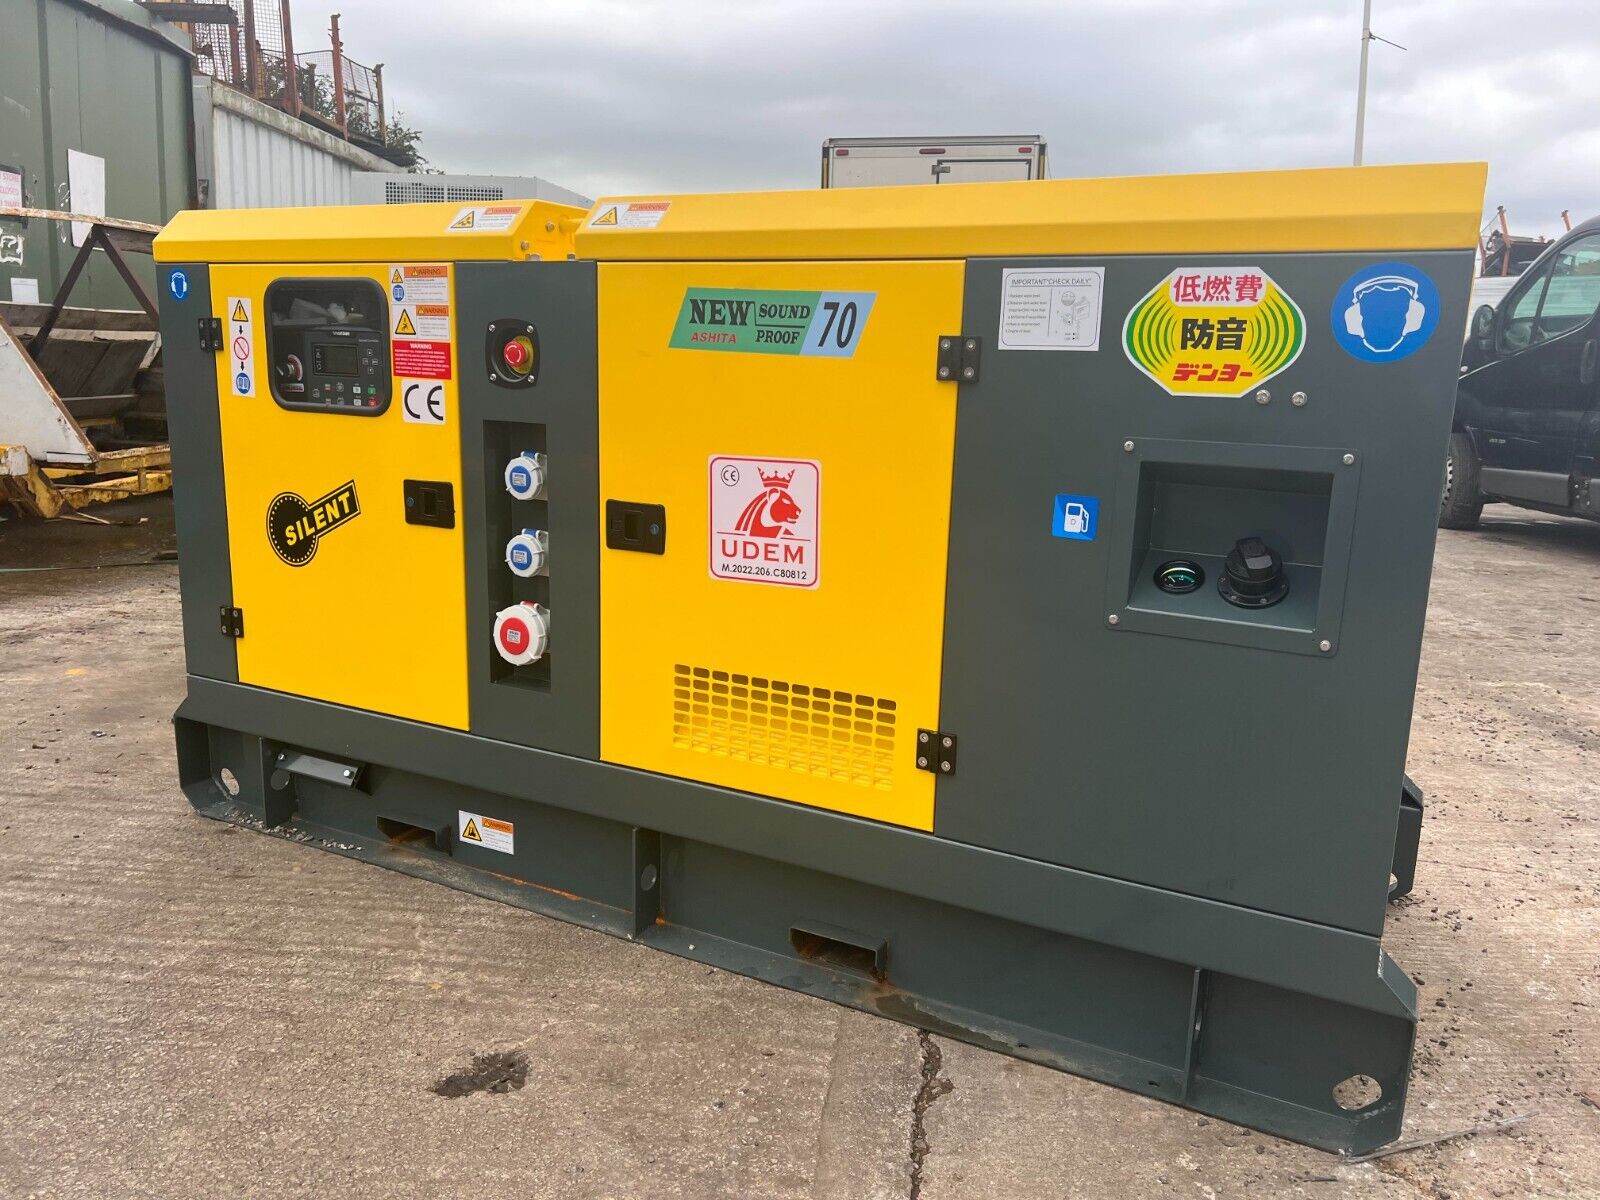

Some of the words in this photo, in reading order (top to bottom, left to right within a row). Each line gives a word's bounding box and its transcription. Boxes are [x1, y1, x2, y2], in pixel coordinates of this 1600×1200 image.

[1173, 274, 1263, 303] 低燃費
[689, 298, 754, 326] NEW
[758, 303, 811, 319] SOUND
[690, 332, 737, 345] ASHITA
[755, 329, 800, 345] PROOF
[817, 301, 858, 349] 70
[1180, 317, 1248, 351] 防音
[1172, 363, 1253, 382] デンヨー
[404, 384, 443, 421] CE
[285, 491, 350, 546] SILENT
[721, 539, 804, 565] UDEM
[721, 563, 807, 580] M.2022.206.C80812
